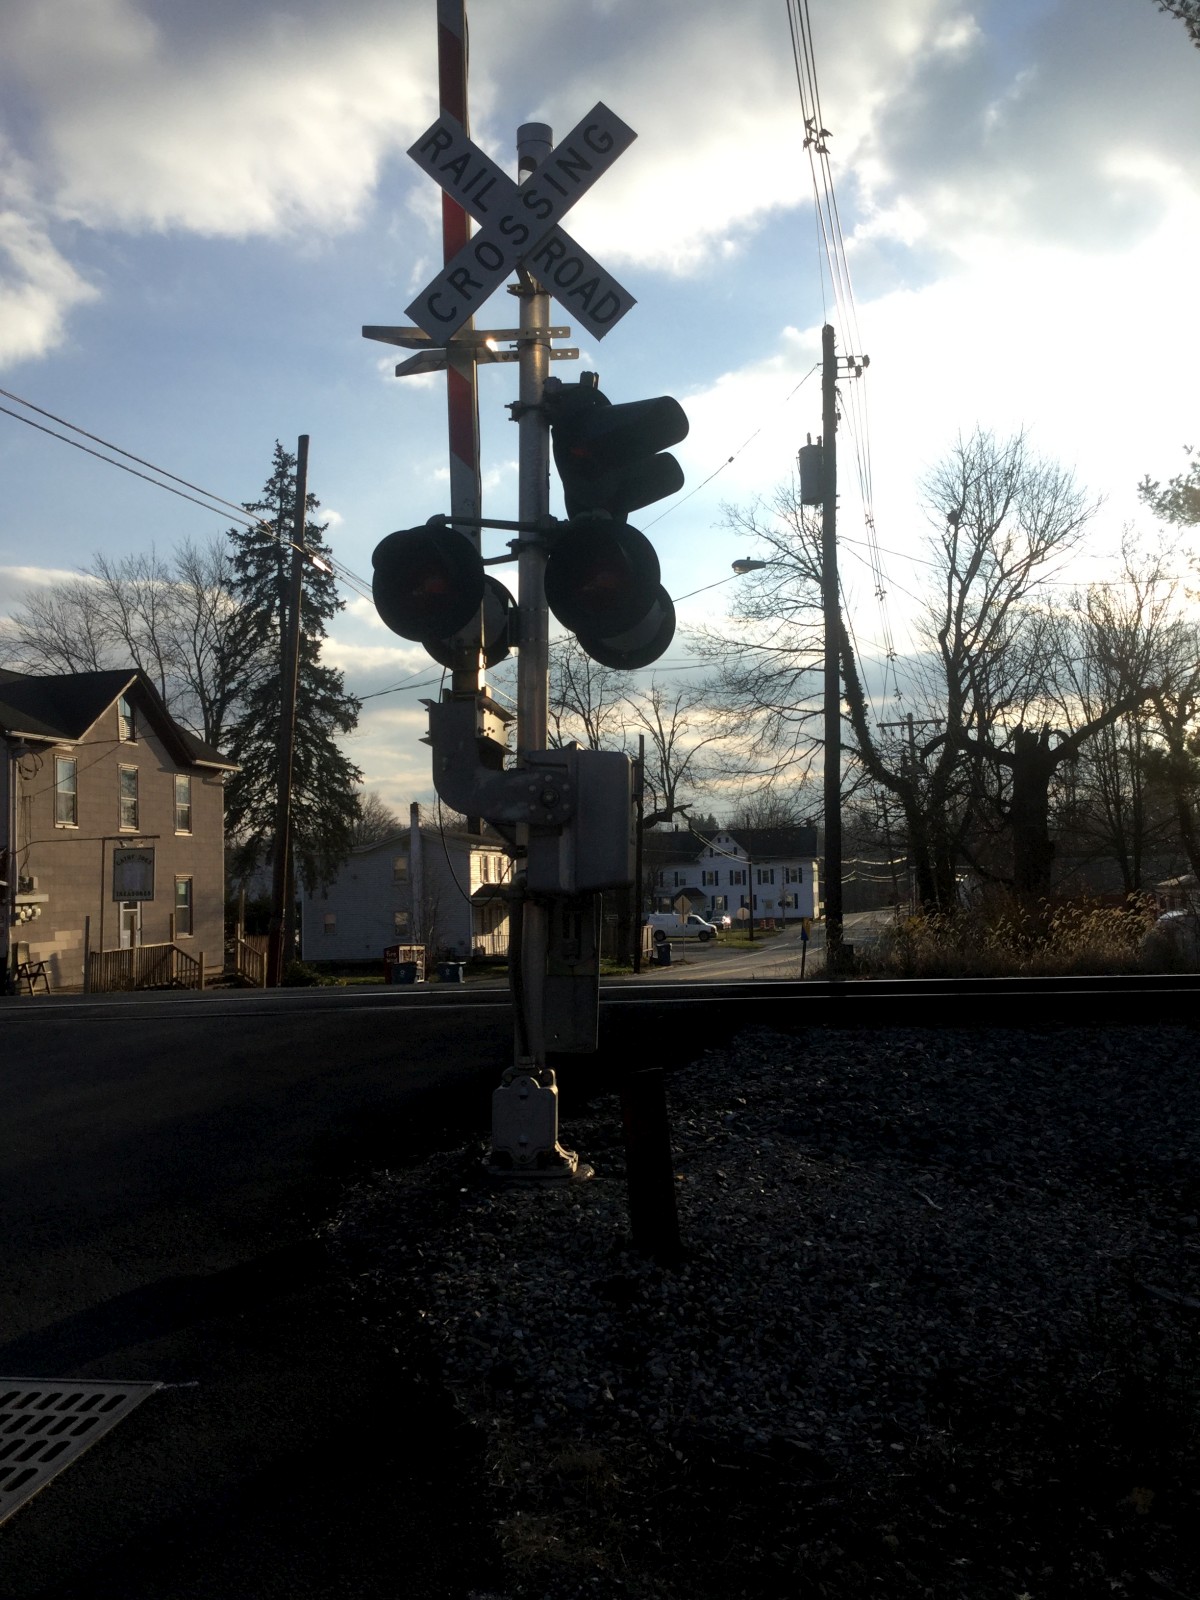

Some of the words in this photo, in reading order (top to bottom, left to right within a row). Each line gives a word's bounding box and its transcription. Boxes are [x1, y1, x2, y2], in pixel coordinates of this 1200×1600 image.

[419, 127, 497, 213] RAIL
[532, 236, 621, 324] ROAD
[427, 124, 614, 322] CROSSING
